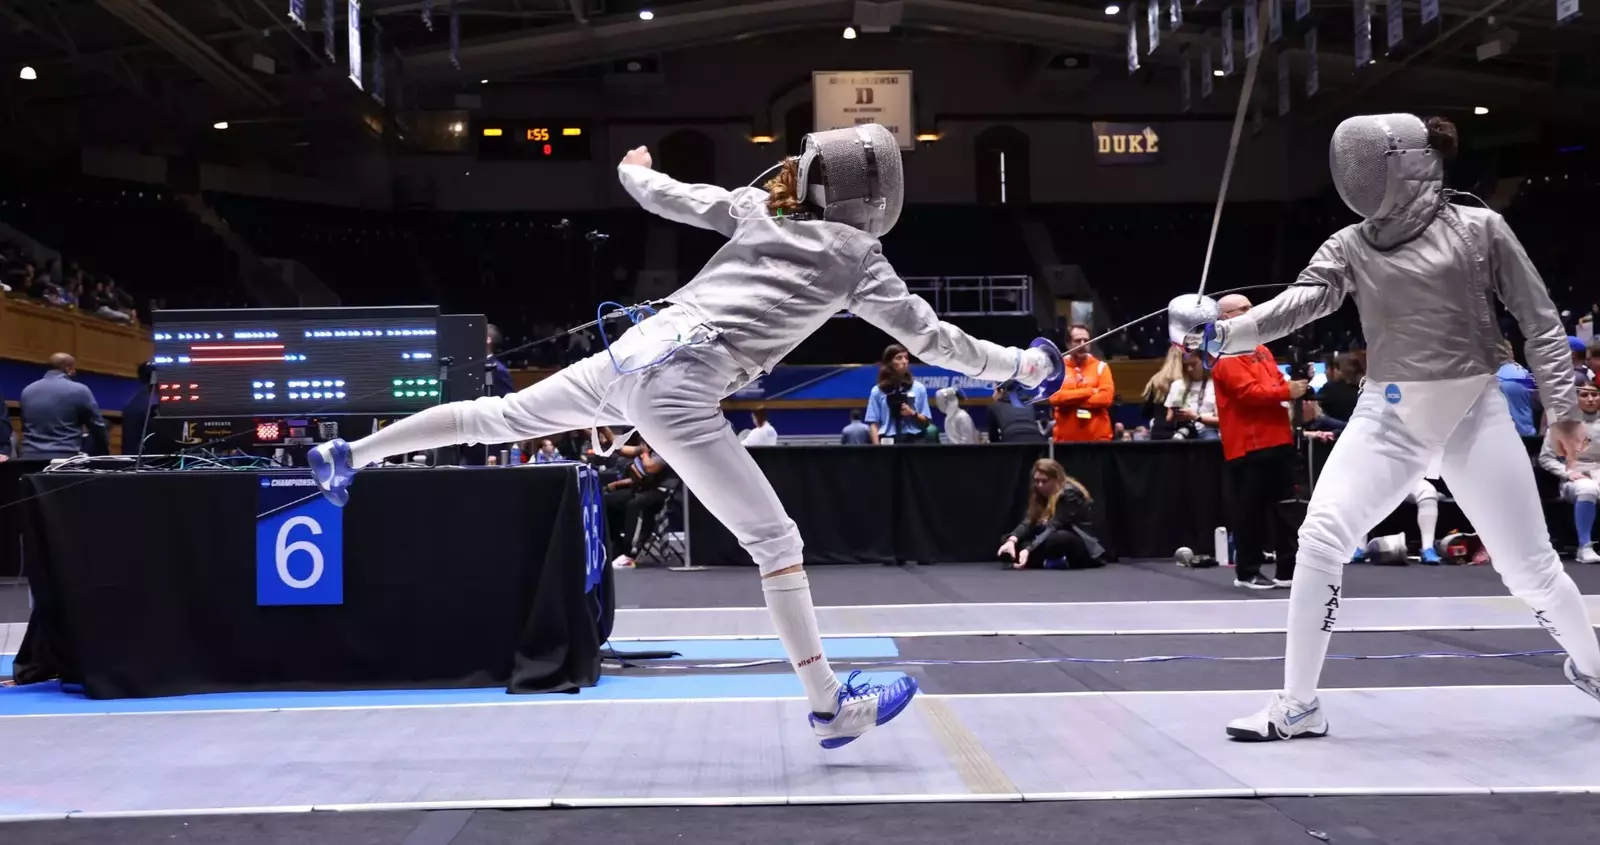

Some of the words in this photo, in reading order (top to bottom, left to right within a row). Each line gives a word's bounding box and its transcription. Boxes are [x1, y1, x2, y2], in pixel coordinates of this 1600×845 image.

[855, 87, 874, 105] D
[527, 128, 549, 141] 1:55
[1097, 134, 1159, 153] DUKE
[275, 515, 325, 589] 6
[1320, 584, 1341, 633] YALE
[797, 653, 822, 668] allstar
